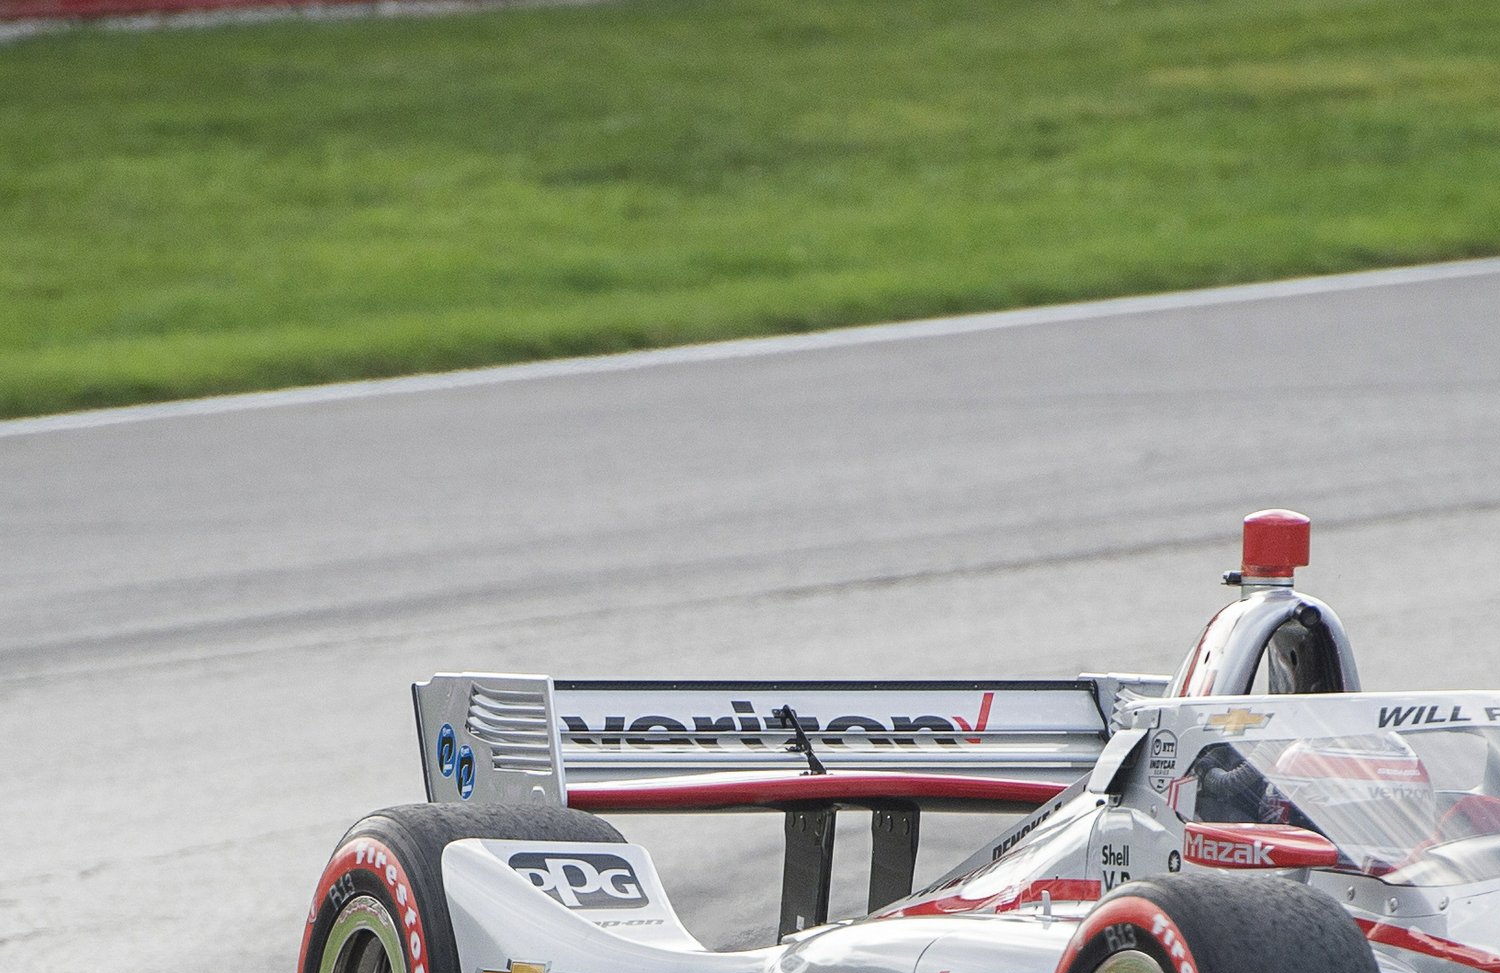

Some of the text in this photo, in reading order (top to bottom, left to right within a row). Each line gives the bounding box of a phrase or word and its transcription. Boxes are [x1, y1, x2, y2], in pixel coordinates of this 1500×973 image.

[1378, 706, 1472, 728] WILL
[1150, 760, 1176, 770] INDYCAR
[1102, 844, 1130, 867] Shell
[1185, 831, 1276, 866] Mazak
[514, 858, 643, 907] PPG
